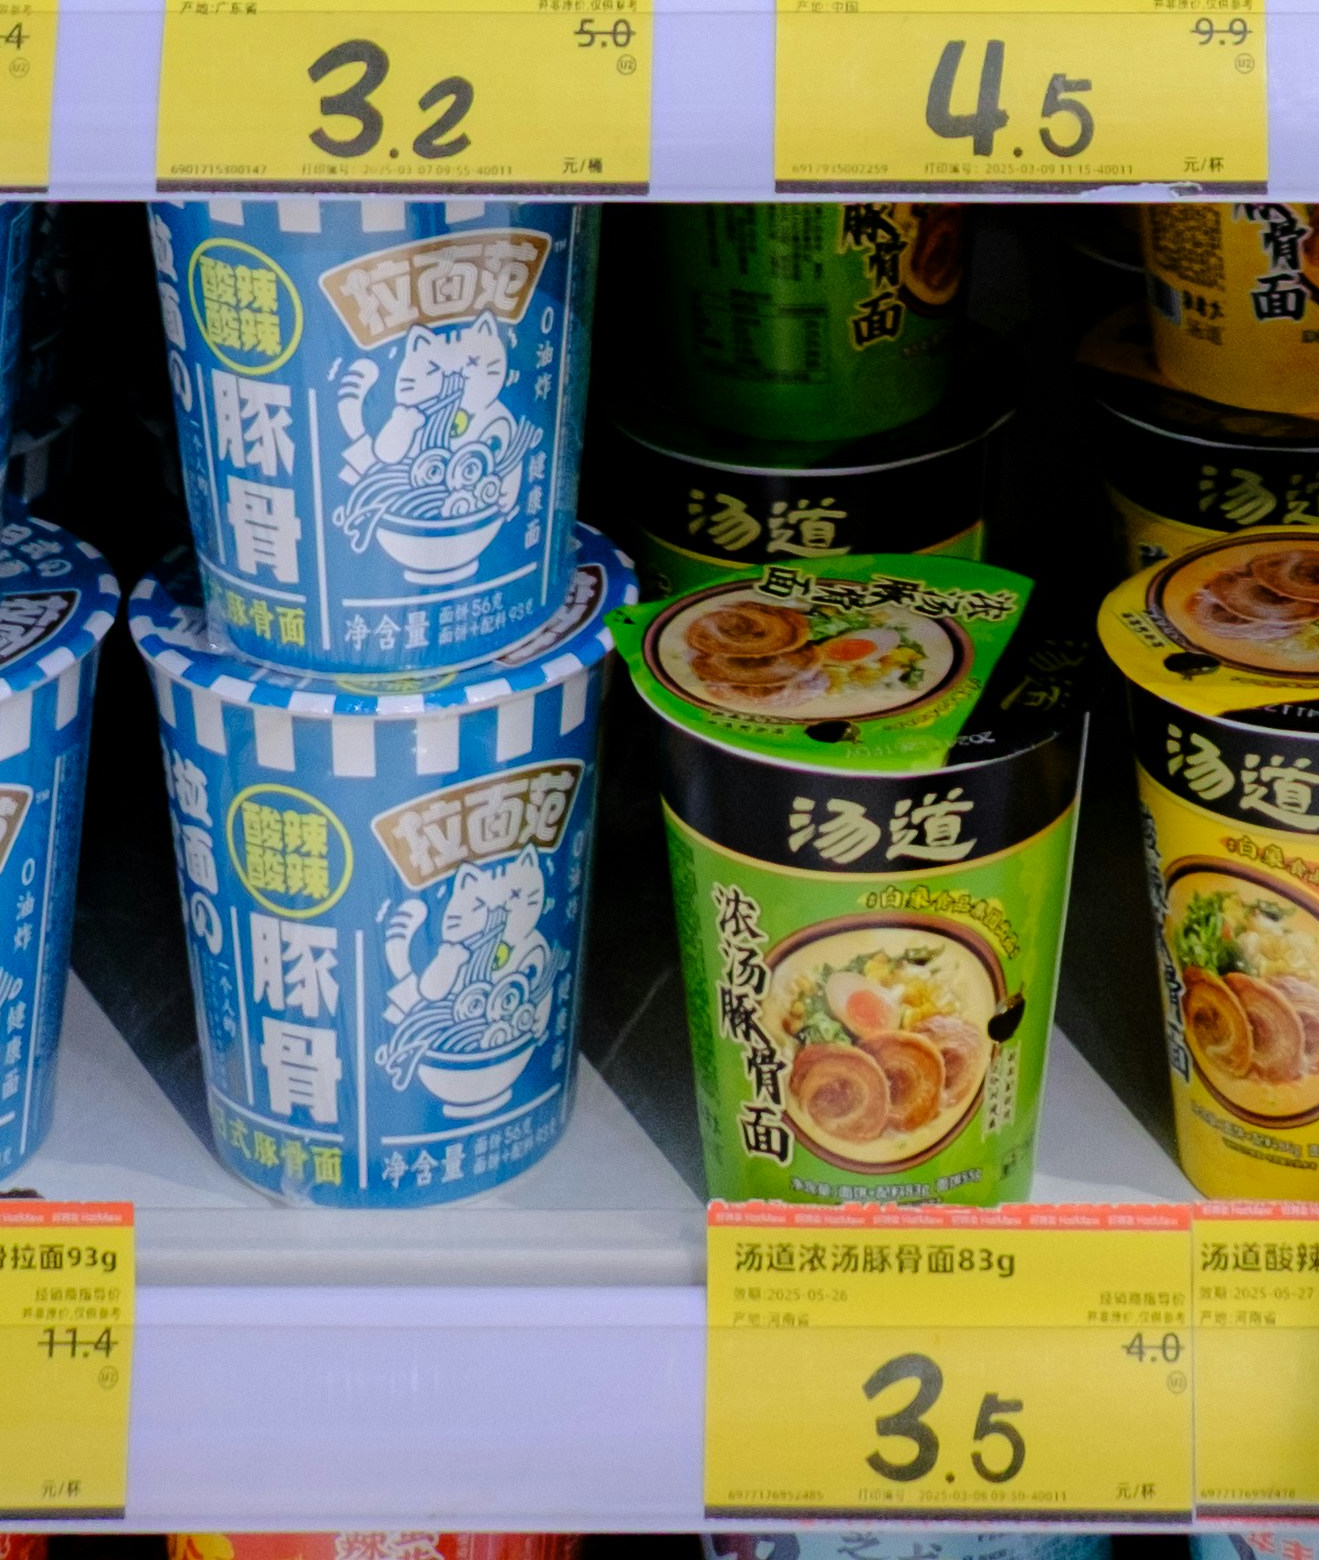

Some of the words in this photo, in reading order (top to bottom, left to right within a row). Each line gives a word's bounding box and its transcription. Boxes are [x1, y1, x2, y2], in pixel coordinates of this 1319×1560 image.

[574, 18, 636, 48] 5.0
[1190, 17, 1253, 46] 9.9
[307, 38, 475, 161] 3.2
[925, 39, 1095, 159] 4.5
[788, 789, 975, 863] 汤道
[254, 923, 344, 1124] 豚骨
[712, 882, 791, 1163] 浓汤豚骨面
[735, 1242, 1017, 1278] 汤道浓汤豚骨面83g
[37, 1327, 118, 1359] 11.4
[1122, 1332, 1184, 1363] 4.0
[861, 1352, 1026, 1484] 3.5
